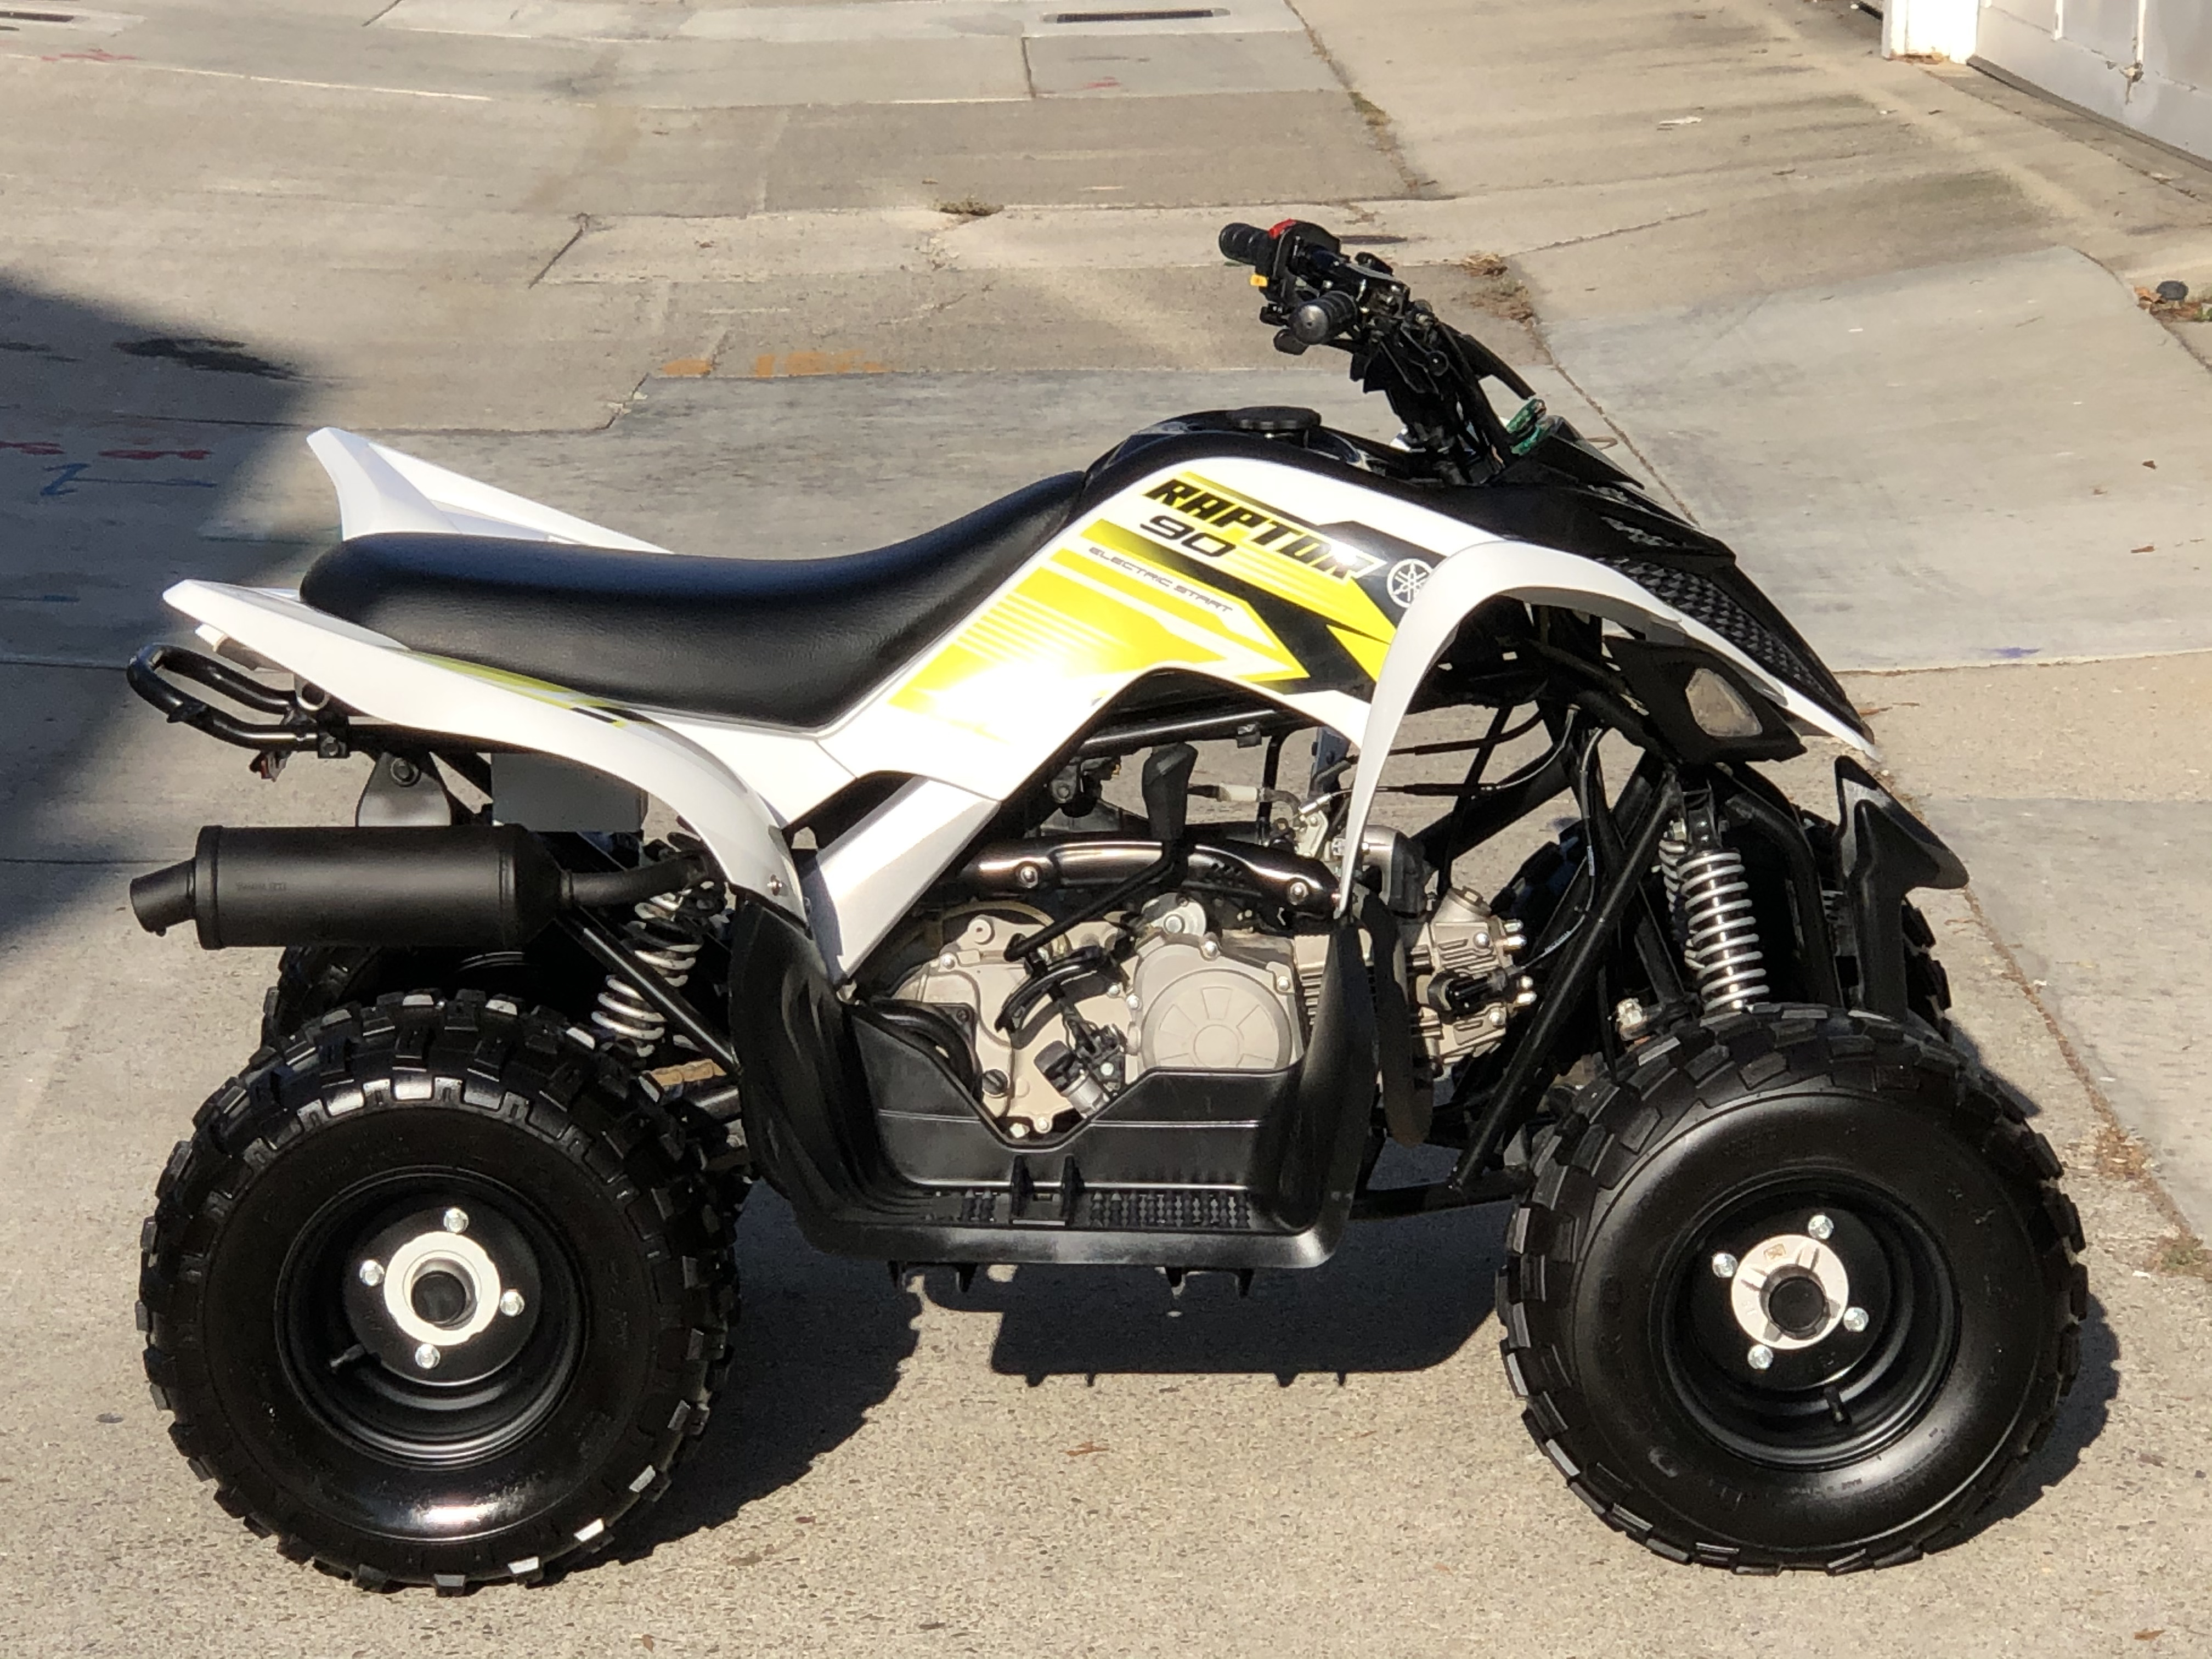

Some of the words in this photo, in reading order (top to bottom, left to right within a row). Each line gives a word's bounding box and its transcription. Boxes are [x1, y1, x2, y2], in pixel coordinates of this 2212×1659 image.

[1139, 515, 1237, 557] 90
[1088, 547, 1173, 587] ELECTRIC
[1173, 585, 1233, 612] START
